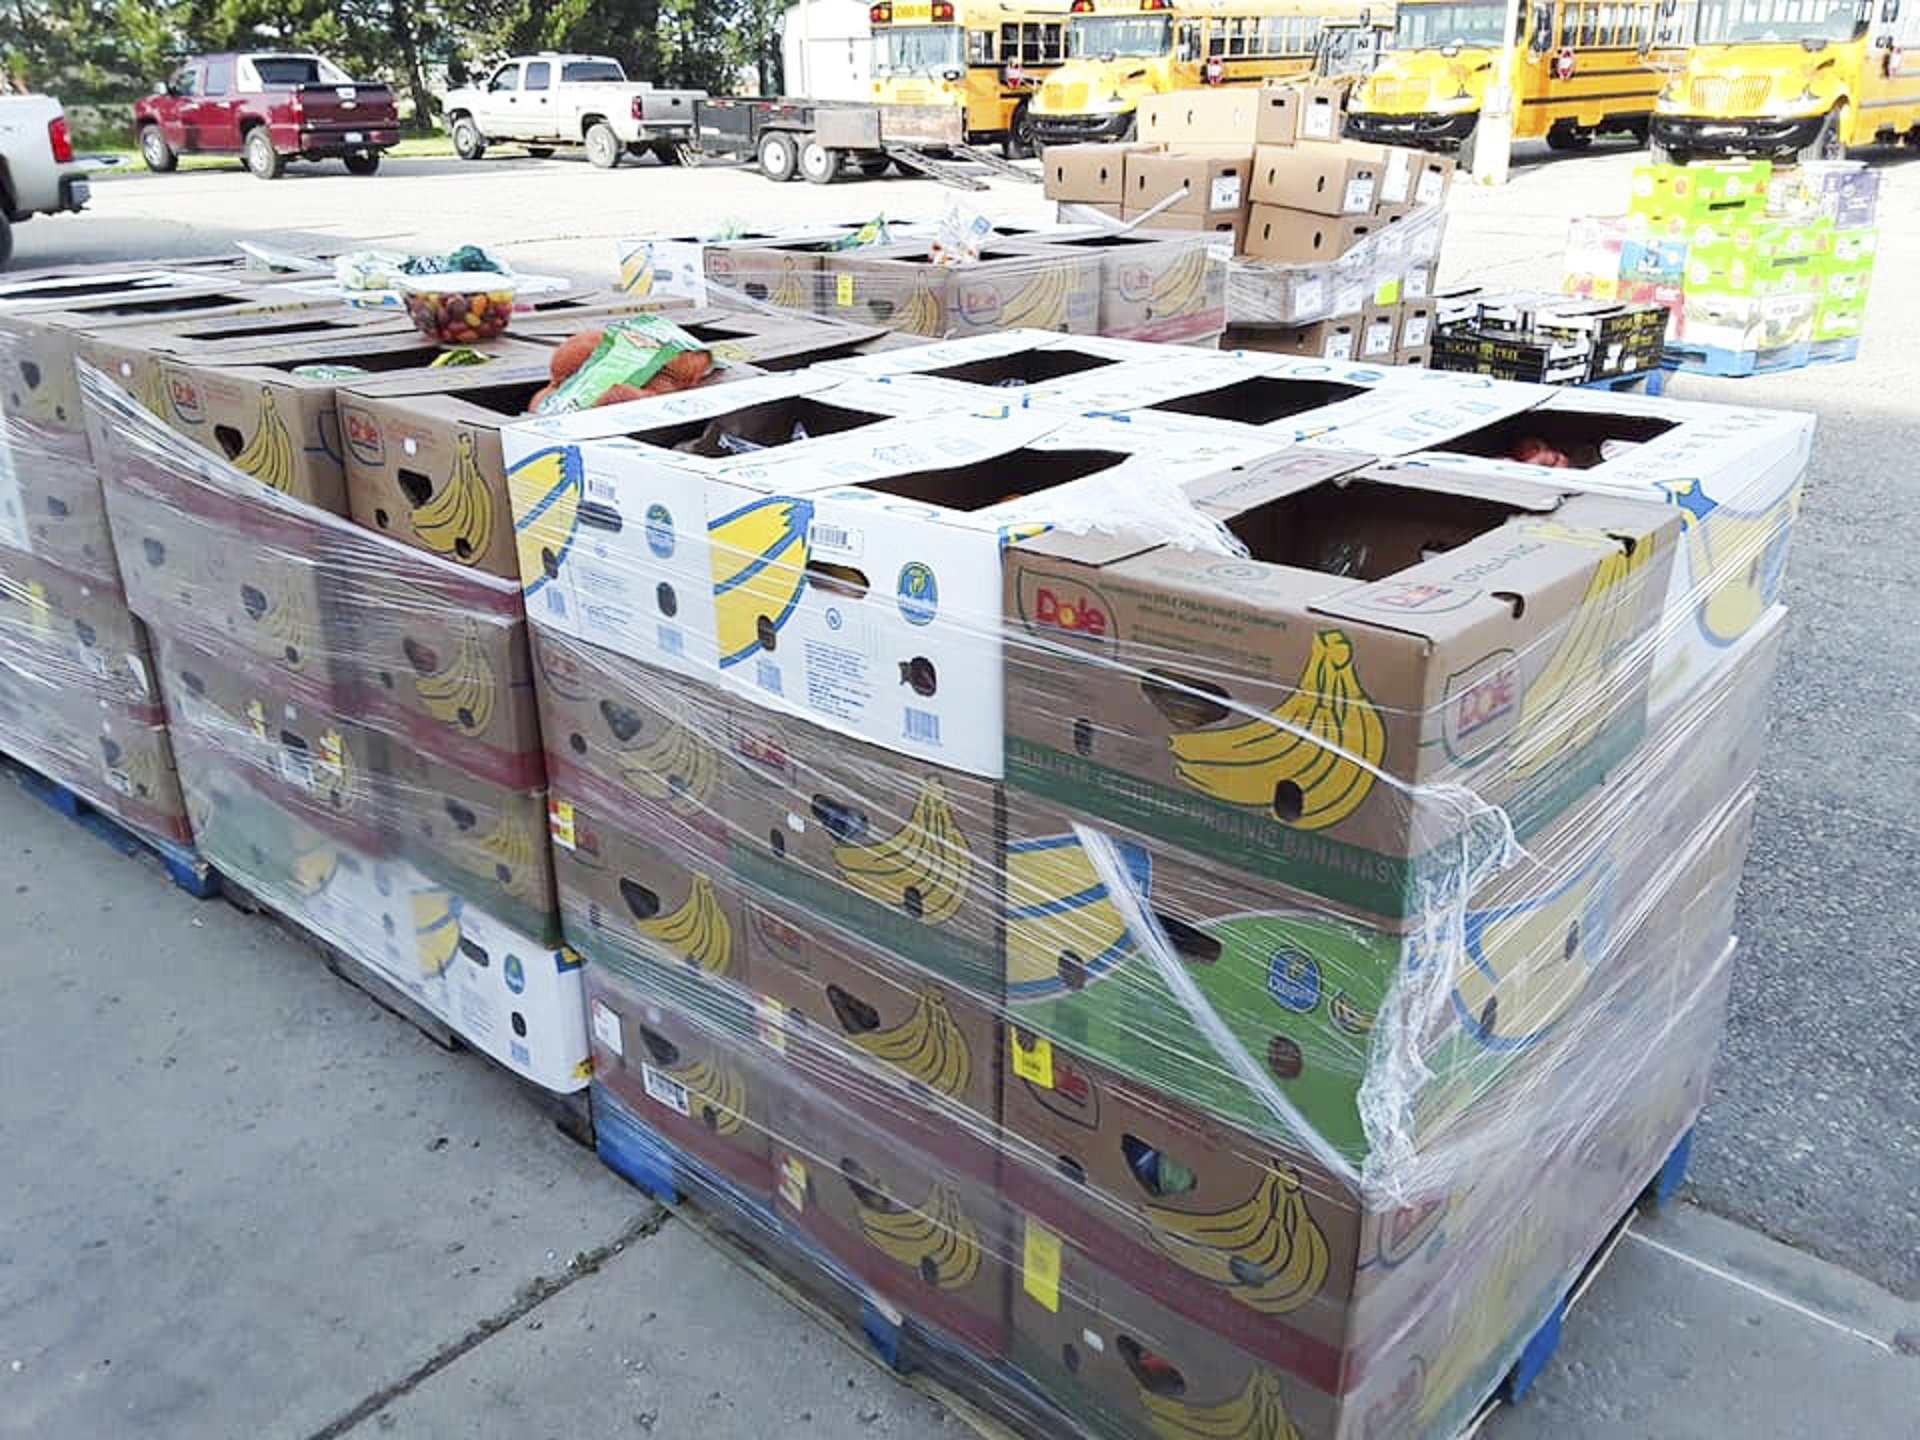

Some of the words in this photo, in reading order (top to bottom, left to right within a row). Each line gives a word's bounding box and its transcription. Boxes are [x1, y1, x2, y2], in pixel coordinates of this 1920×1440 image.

[349, 415, 380, 444] Dole
[1036, 587, 1105, 635] Dole
[1282, 829, 1391, 883] BANANAS
